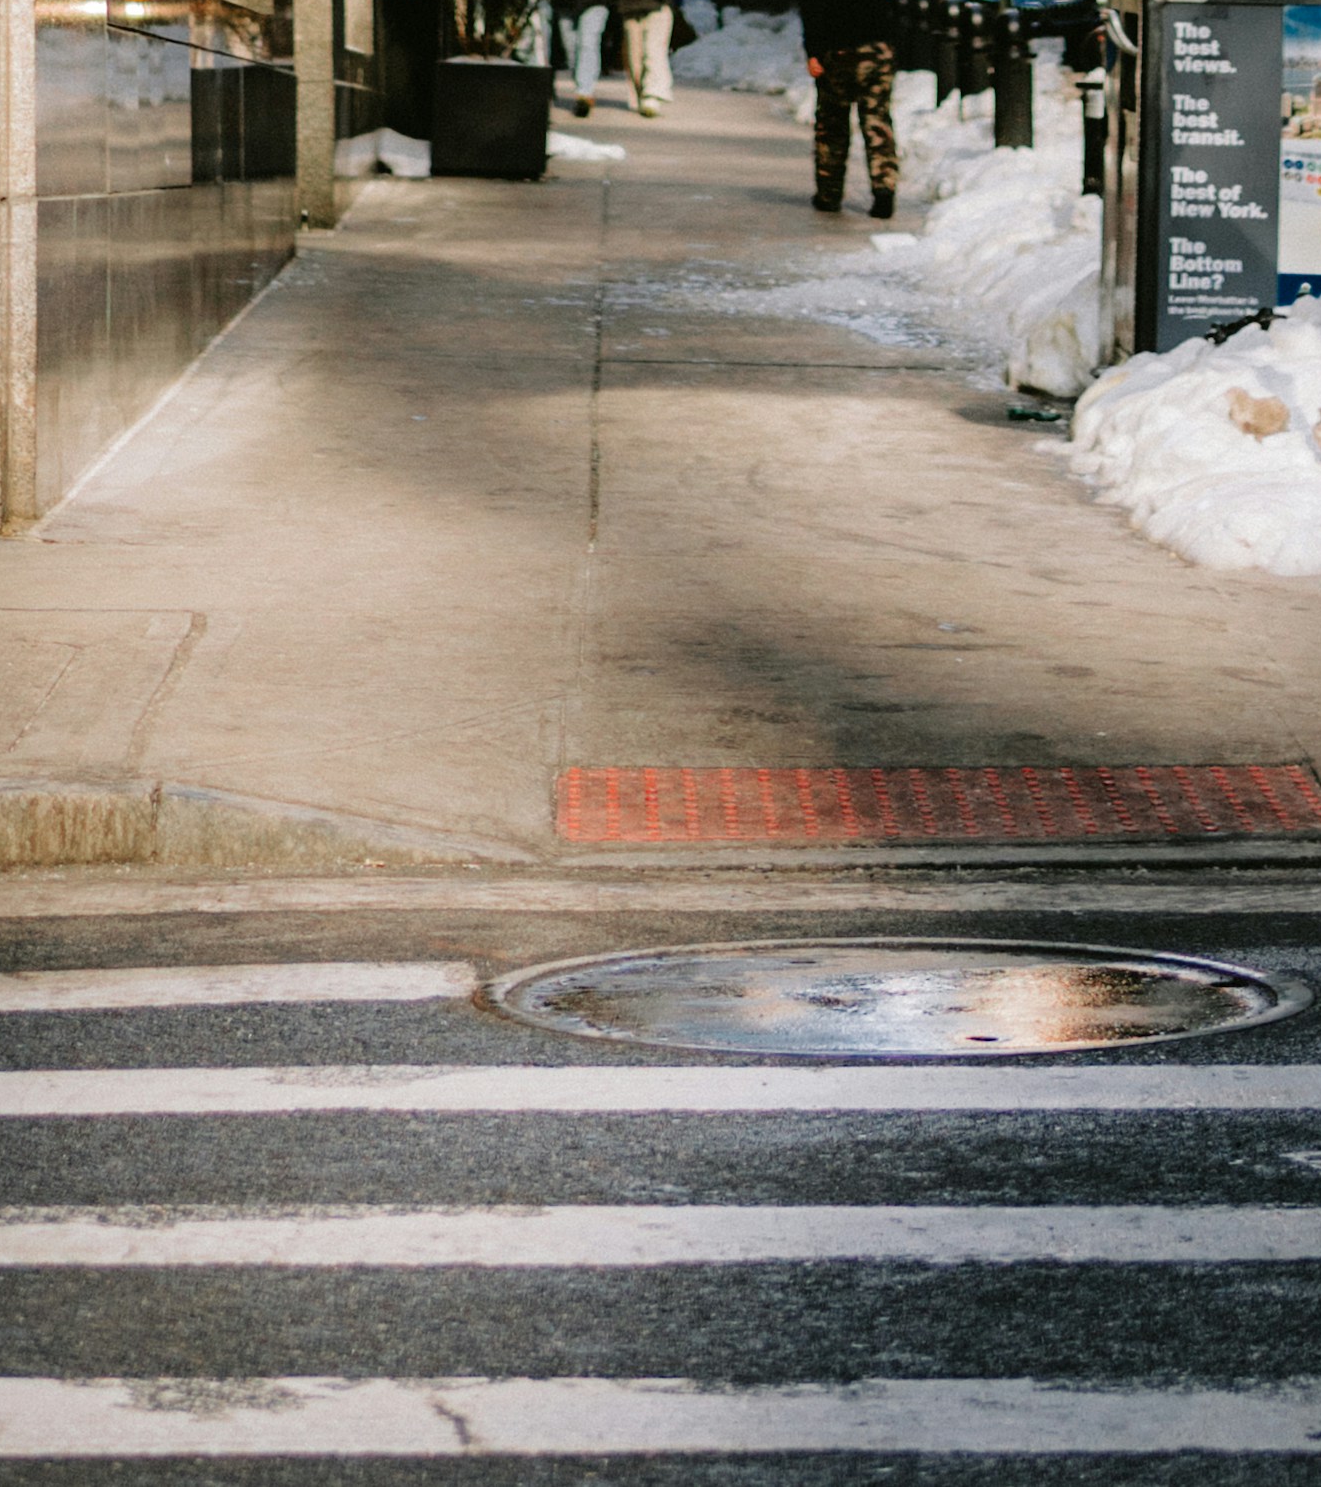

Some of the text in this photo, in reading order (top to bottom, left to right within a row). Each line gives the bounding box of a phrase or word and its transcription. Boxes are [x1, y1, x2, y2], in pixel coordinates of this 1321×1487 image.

[1174, 22, 1211, 39] The
[1174, 40, 1220, 56] best
[1174, 56, 1237, 73] views.
[1172, 94, 1210, 111] The
[1172, 111, 1218, 128] best
[1171, 129, 1245, 146] transit.
[1170, 167, 1208, 184] The
[1171, 184, 1242, 201] best of
[1171, 201, 1269, 219] New York.
[1169, 237, 1206, 254] The
[1169, 255, 1243, 273] Bottom
[1169, 273, 1224, 290] Line?
